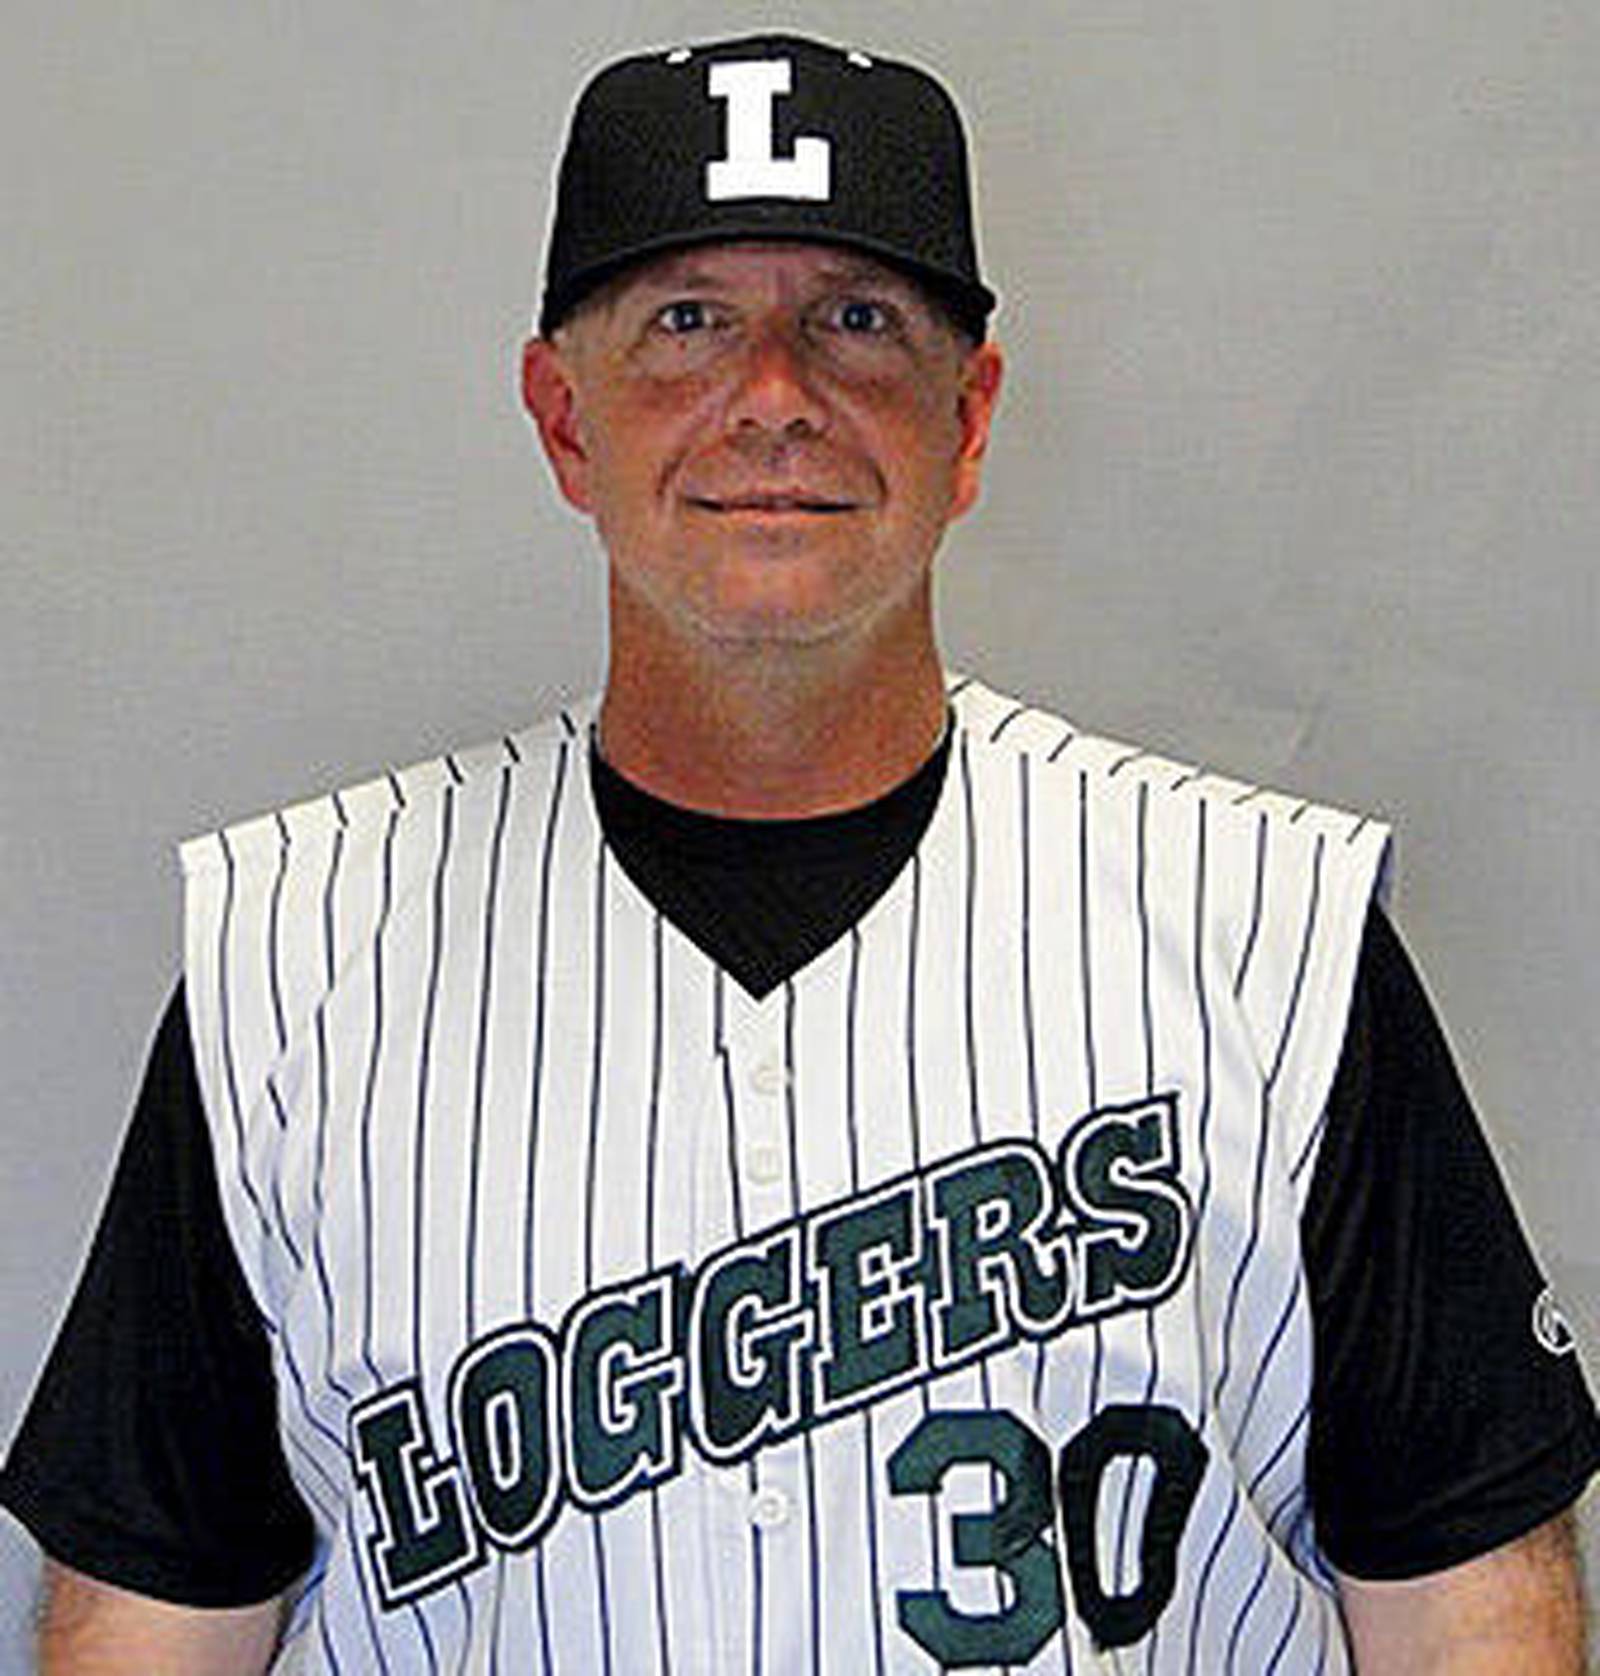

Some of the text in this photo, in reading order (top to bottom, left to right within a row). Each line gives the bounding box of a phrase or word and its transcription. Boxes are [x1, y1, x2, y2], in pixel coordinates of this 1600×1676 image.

[707, 59, 830, 201] L
[349, 1092, 1197, 1611] LOGGERS
[888, 1404, 1209, 1667] 30
